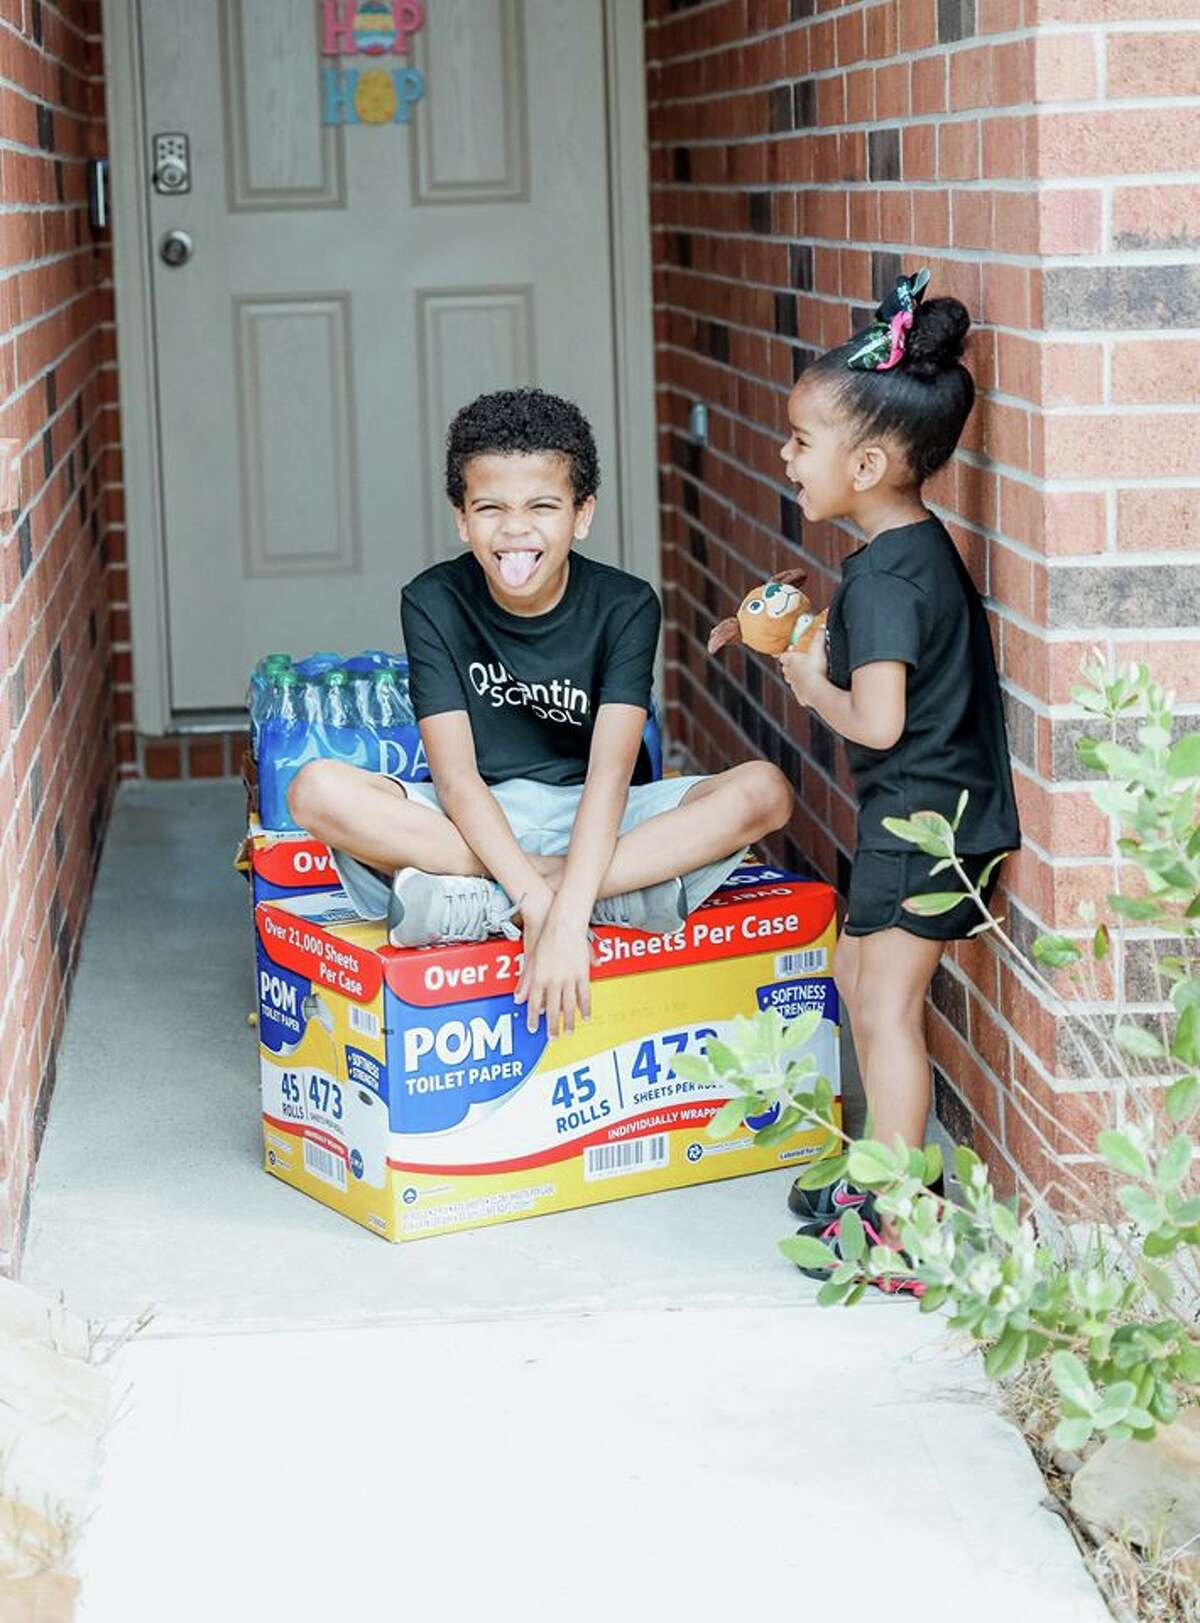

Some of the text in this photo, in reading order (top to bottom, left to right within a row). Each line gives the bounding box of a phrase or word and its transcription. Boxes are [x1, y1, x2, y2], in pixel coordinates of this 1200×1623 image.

[379, 739, 429, 777] DA
[264, 916, 359, 973] Over 21,000 Sheets
[424, 915, 800, 991] Over 21 Sheets Per Case
[260, 970, 298, 1016] POM
[319, 961, 363, 996] Per Case
[771, 984, 827, 1005] SOFTNESS
[404, 1012, 514, 1073] POM
[281, 1072, 300, 1104] 45
[405, 1060, 524, 1096] TOILET PAPER
[551, 1066, 597, 1110] 45
[633, 1085, 673, 1105] SHEETS
[281, 1102, 305, 1120] ROLLS
[308, 1074, 344, 1120] 473
[555, 1099, 612, 1134] ROLLS
[607, 1106, 721, 1140] INDIVIDUALLY WRAPP
